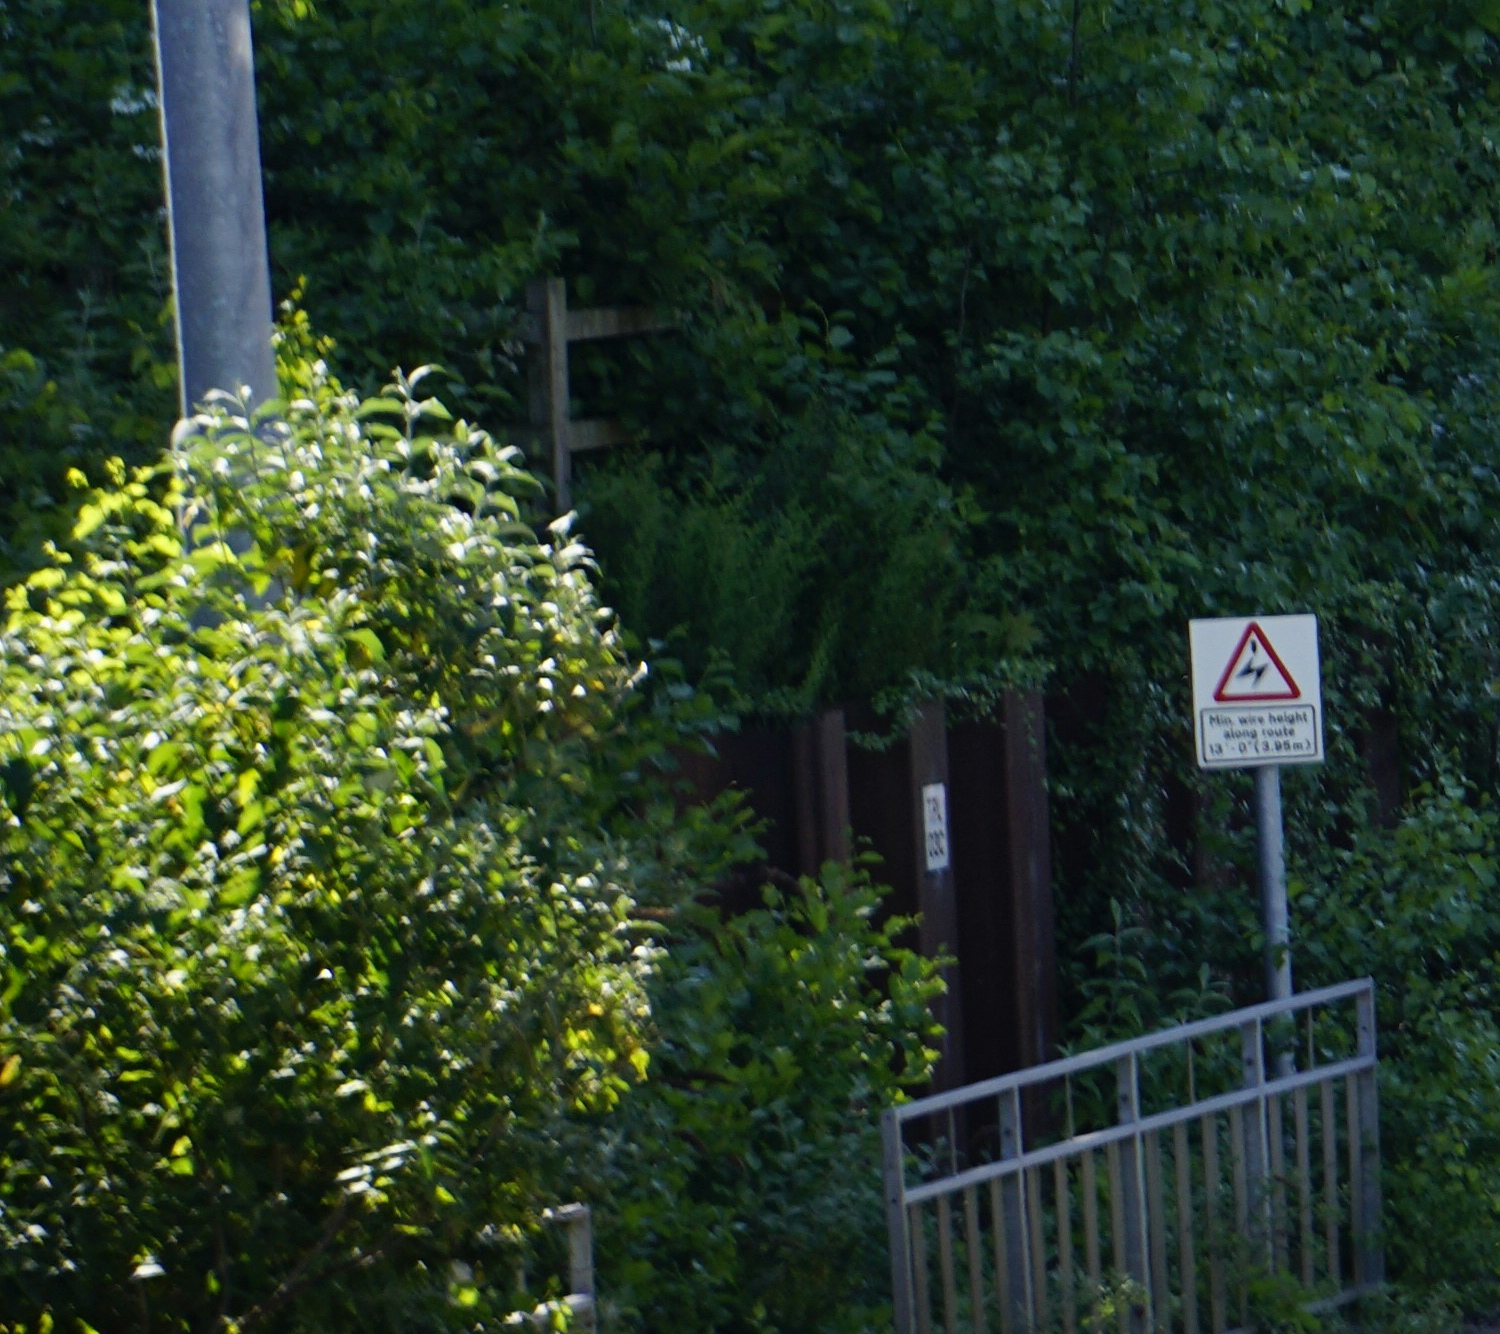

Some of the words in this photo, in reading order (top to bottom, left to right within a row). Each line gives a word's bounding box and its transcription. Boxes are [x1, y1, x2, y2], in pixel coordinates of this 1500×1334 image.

[1238, 714, 1265, 725] wire
[1269, 711, 1308, 724] height
[1223, 727, 1257, 740] along
[1262, 726, 1295, 737] route
